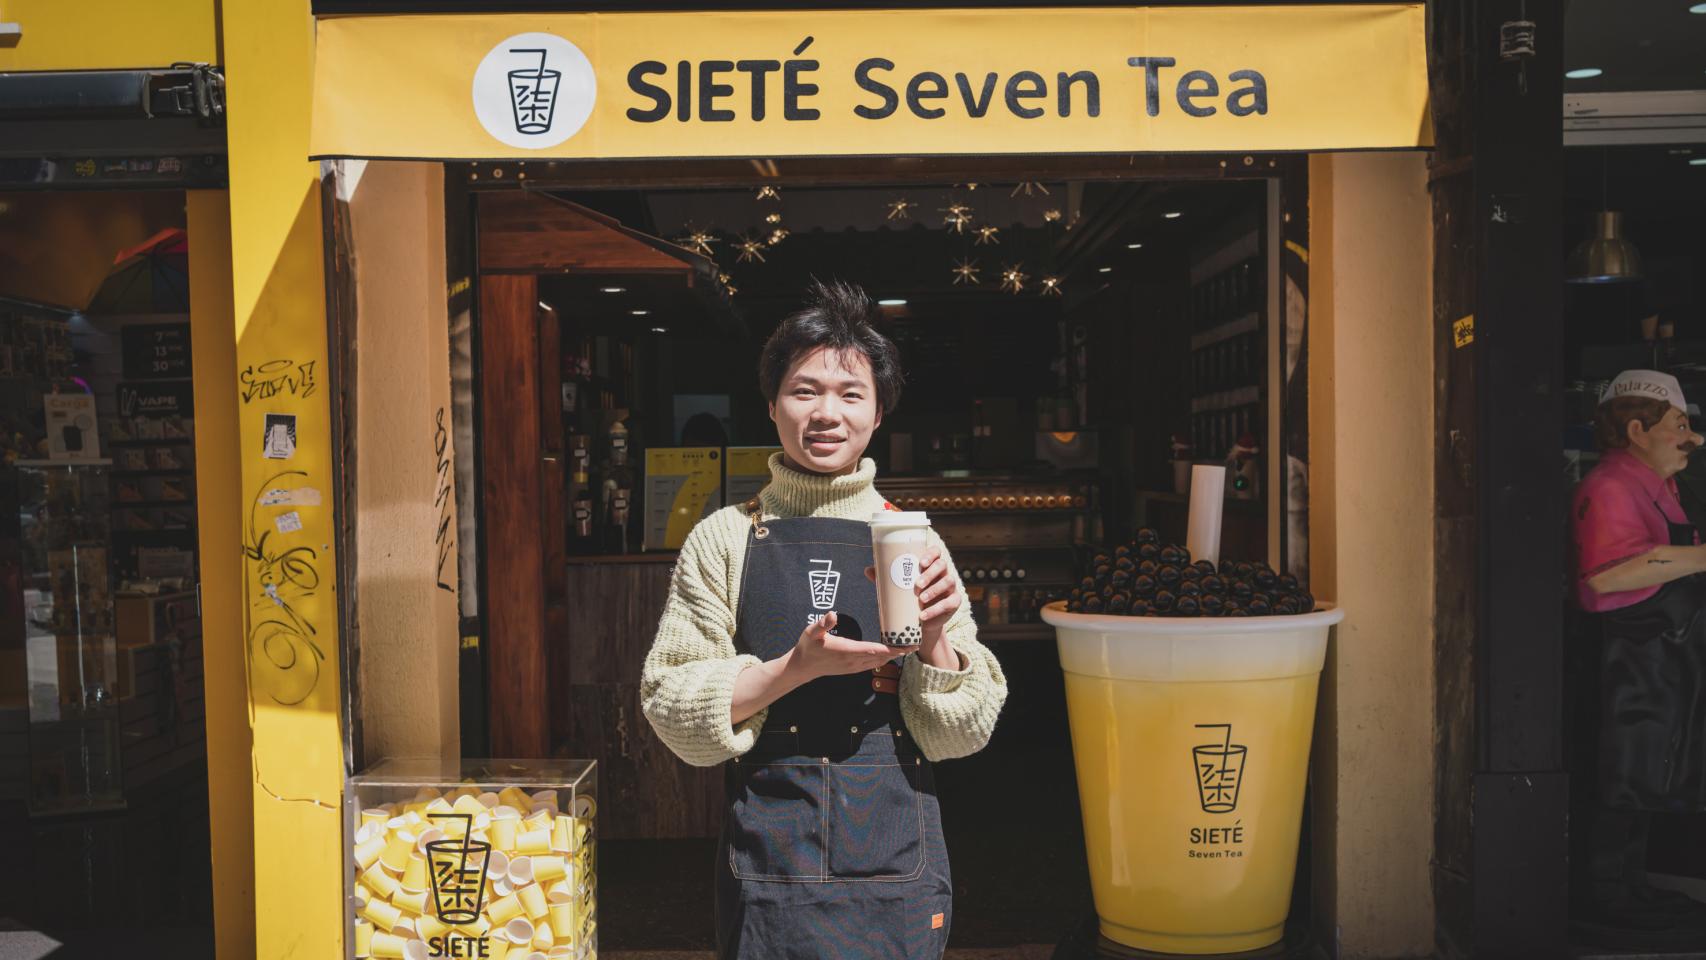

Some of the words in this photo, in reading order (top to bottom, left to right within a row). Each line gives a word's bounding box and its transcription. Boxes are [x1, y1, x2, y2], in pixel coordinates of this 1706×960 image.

[626, 36, 821, 122] SIETÉ
[853, 57, 1101, 120] Seven
[1128, 56, 1268, 117] Tea
[1614, 380, 1668, 397] Palazzo
[138, 395, 178, 407] VAPE
[1190, 819, 1243, 845] SIETÉ
[1188, 849, 1222, 859] Seven
[1225, 849, 1243, 858] Tea
[428, 930, 490, 958] SIETÉ
